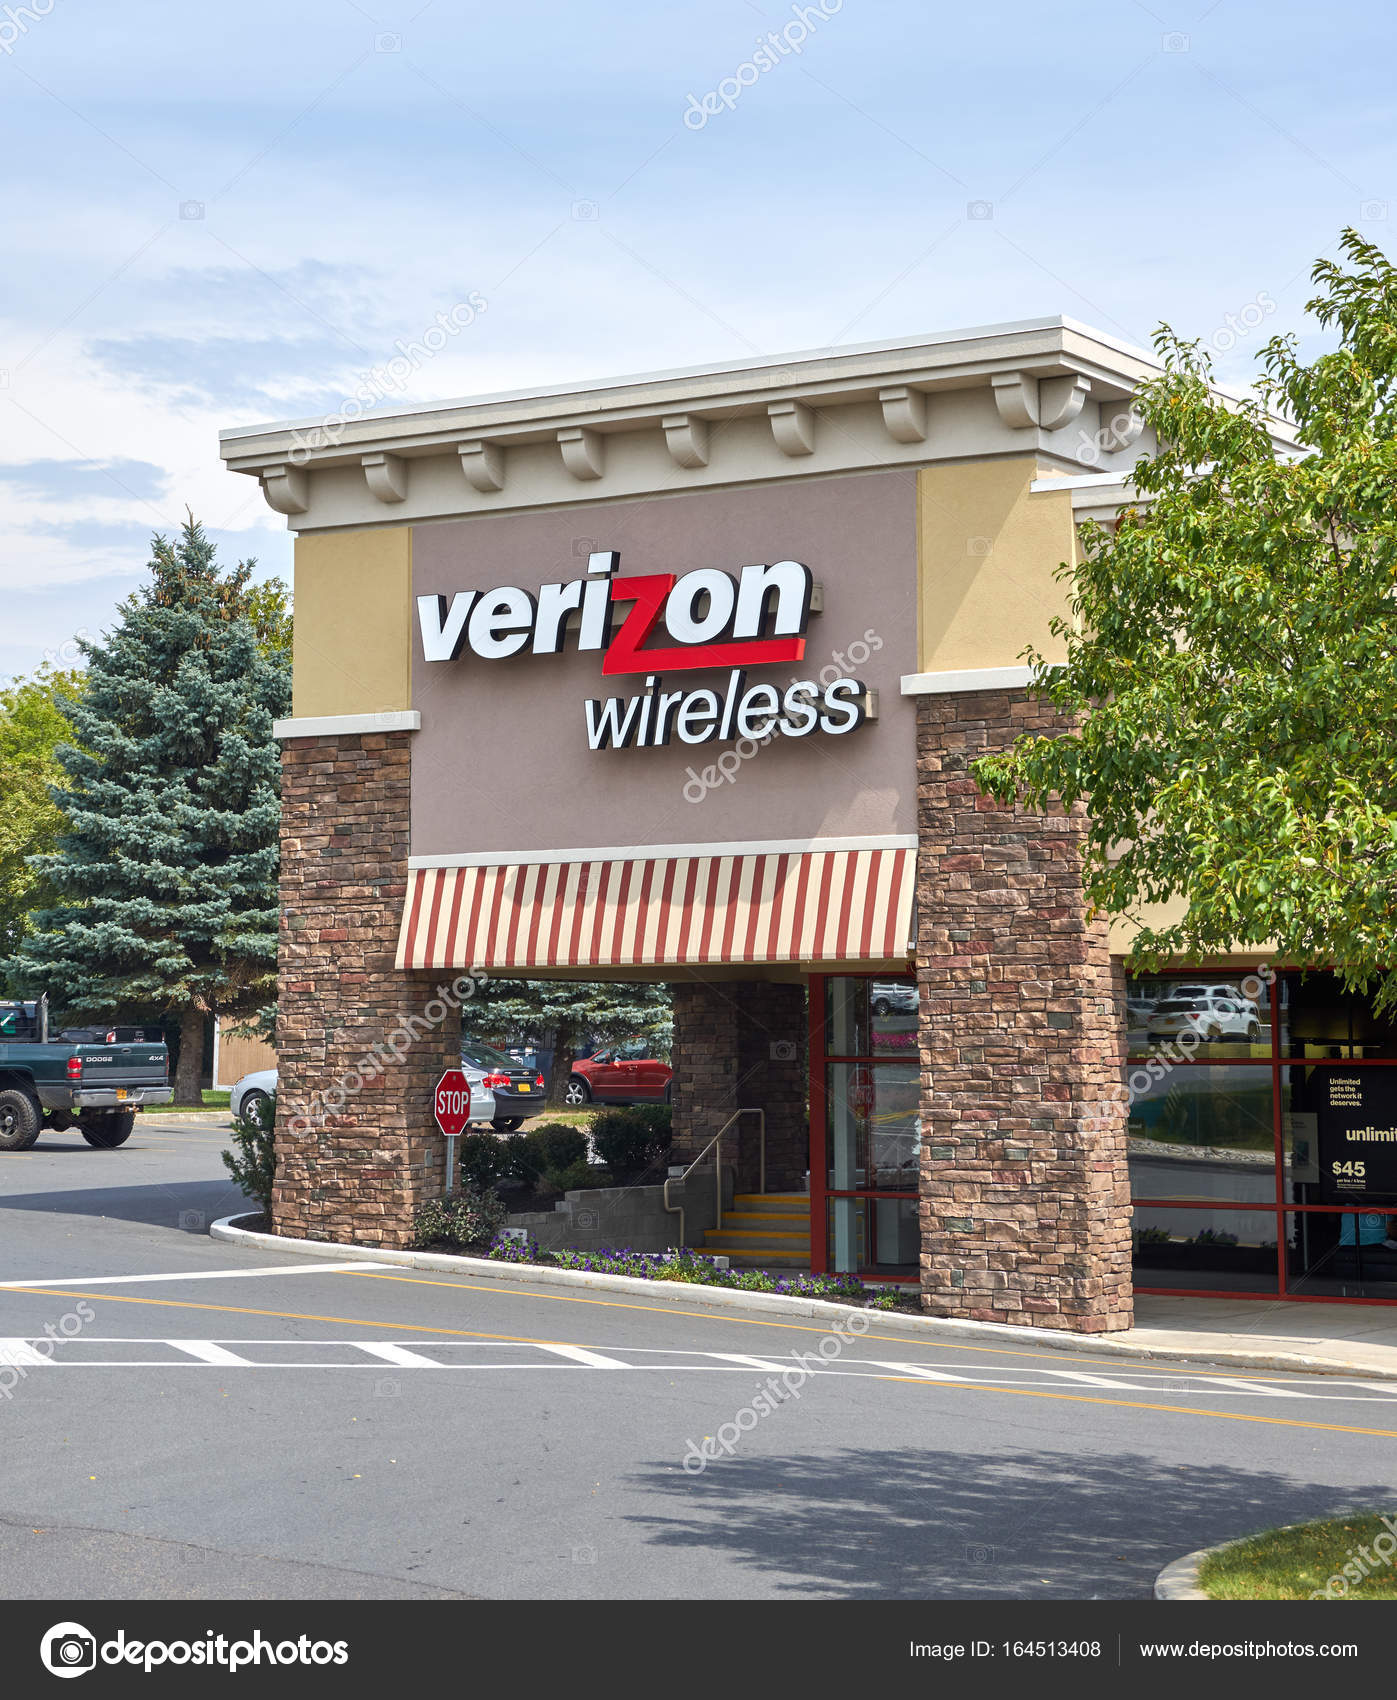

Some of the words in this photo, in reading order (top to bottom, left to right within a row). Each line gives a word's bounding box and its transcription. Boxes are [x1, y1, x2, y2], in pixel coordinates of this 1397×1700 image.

[416, 551, 812, 675] verizon
[584, 669, 866, 750] wireless
[437, 1090, 469, 1115] STOP
[1329, 1099, 1362, 1107] deserves.
[1332, 1160, 1366, 1177] $45
